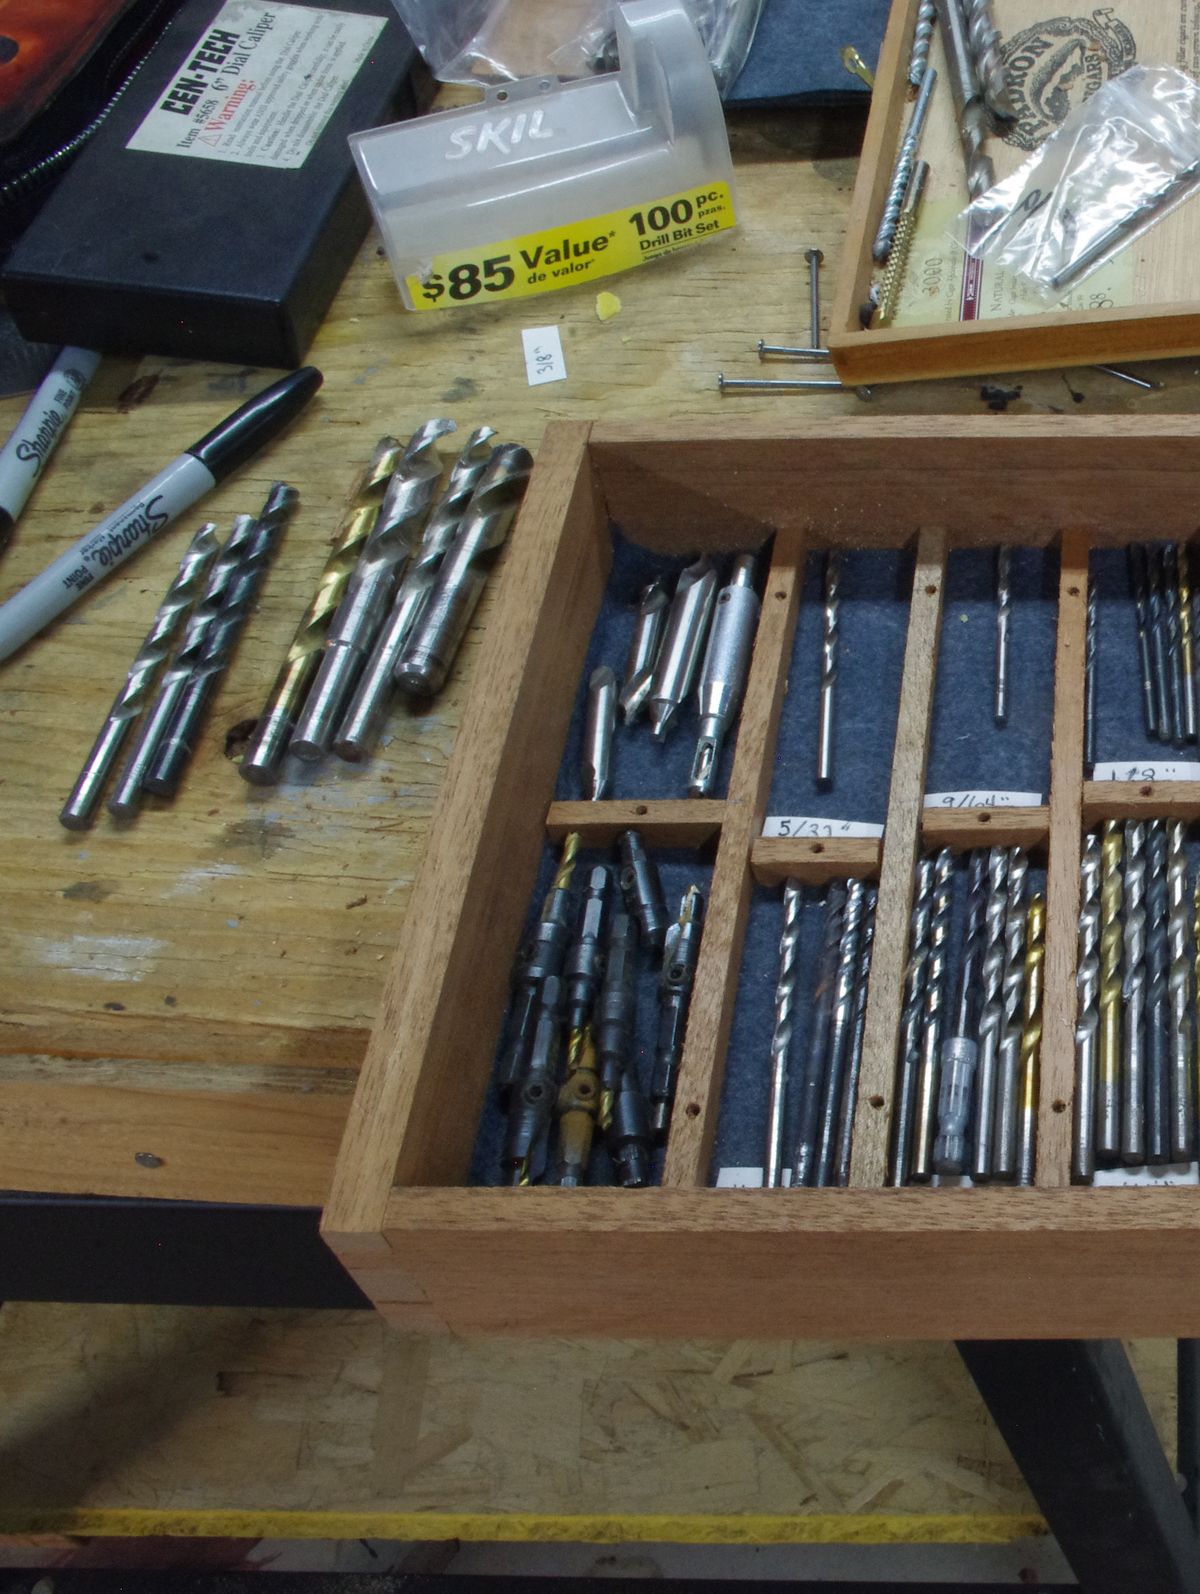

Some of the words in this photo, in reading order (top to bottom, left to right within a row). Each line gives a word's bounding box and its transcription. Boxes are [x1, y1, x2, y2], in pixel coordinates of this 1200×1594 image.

[159, 28, 240, 116] CEN-TECH
[176, 128, 200, 149] Item
[194, 98, 219, 125] #5658
[222, 51, 250, 76] Dial
[239, 12, 277, 53] Caliper
[203, 79, 256, 133] Warning:
[444, 109, 554, 161] SKIL
[629, 199, 693, 236] 100
[695, 191, 724, 208] pc.
[640, 234, 670, 250] Drill
[673, 228, 693, 241] Bit
[696, 220, 720, 234] Set
[422, 254, 515, 303] $85
[527, 271, 547, 285] de
[16, 409, 61, 478] Sharpie
[93, 494, 169, 567] Sharpie
